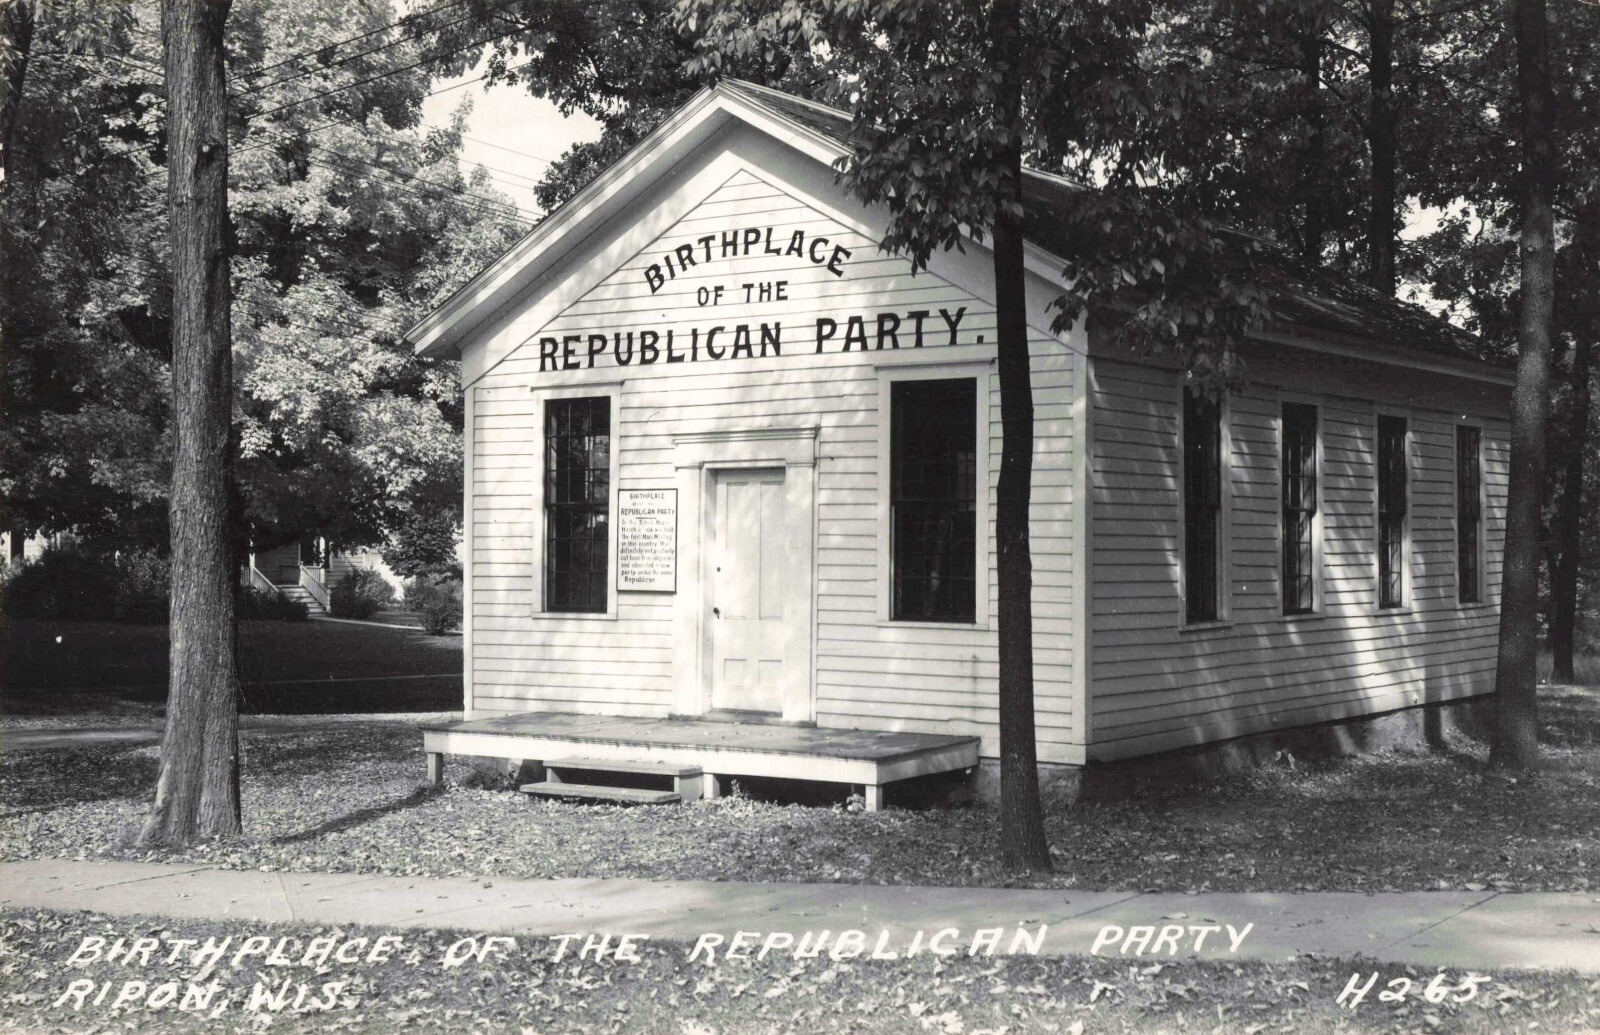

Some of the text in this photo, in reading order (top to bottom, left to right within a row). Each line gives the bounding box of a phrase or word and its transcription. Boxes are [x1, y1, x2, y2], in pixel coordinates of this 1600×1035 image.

[643, 227, 852, 294] BIRTHPLACE
[697, 280, 789, 307] OF THE
[538, 307, 985, 372] REPUBLICAN PARTY.
[624, 576, 655, 584] Republican
